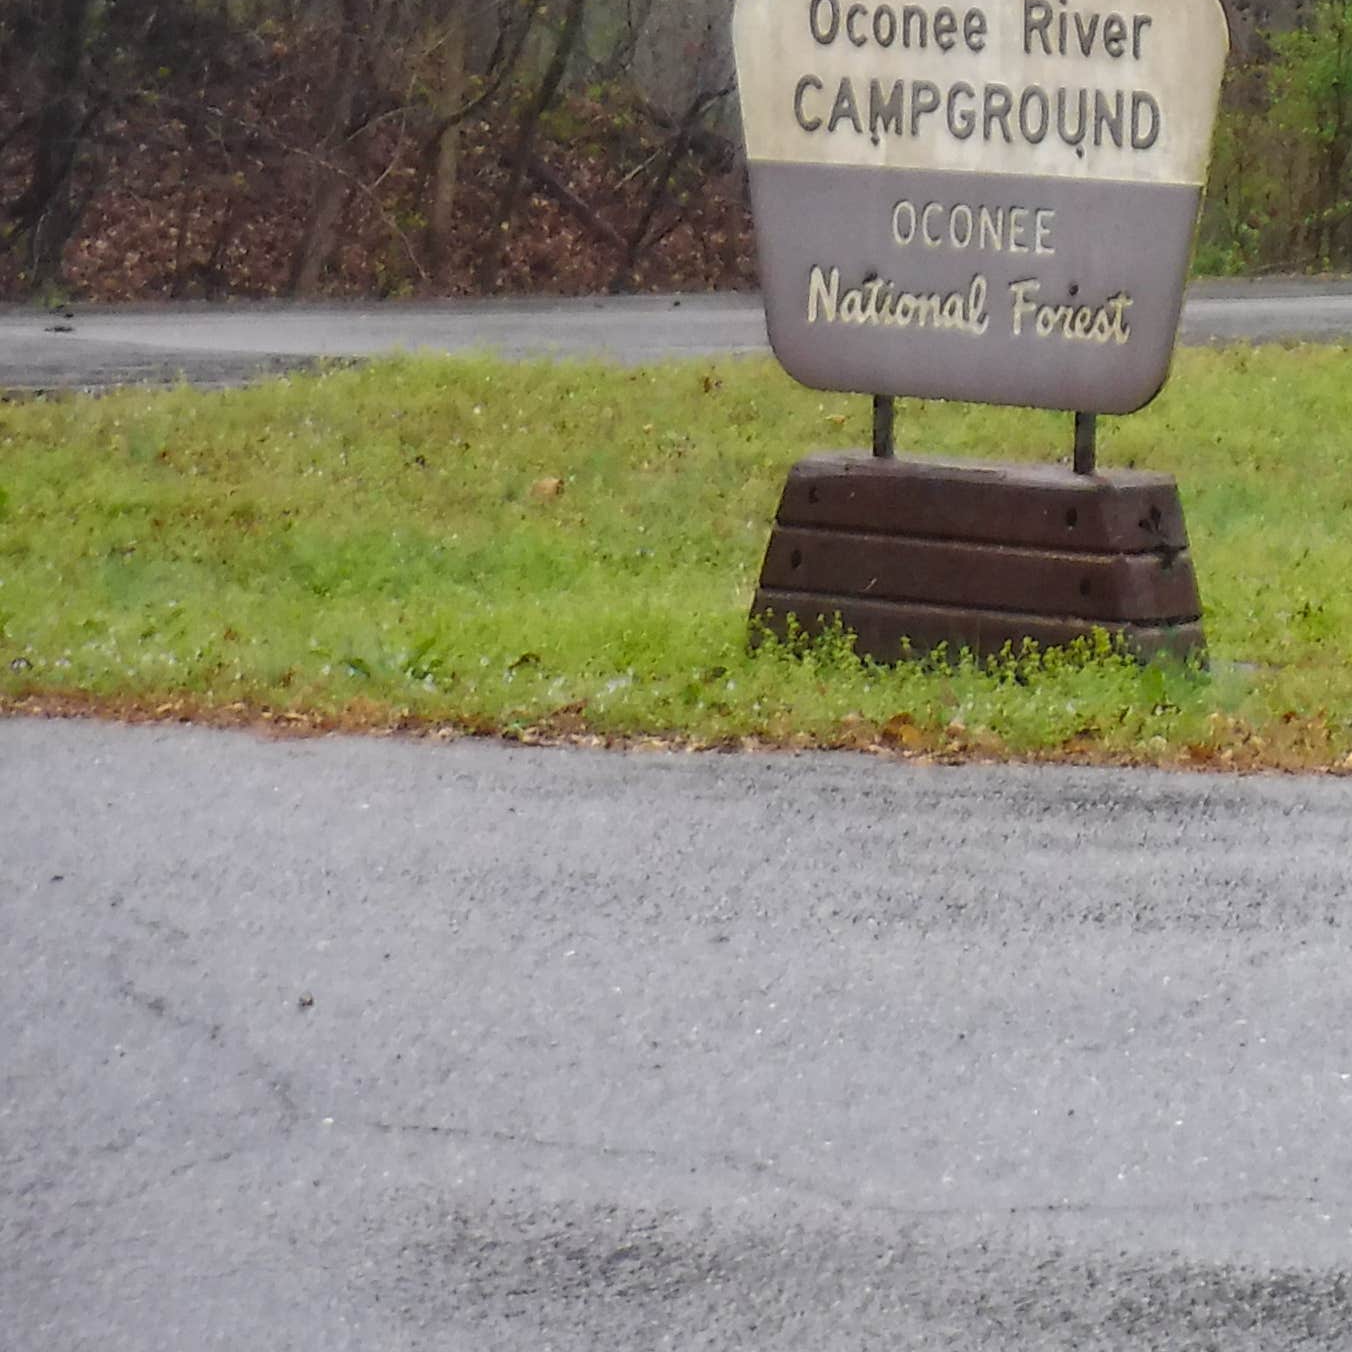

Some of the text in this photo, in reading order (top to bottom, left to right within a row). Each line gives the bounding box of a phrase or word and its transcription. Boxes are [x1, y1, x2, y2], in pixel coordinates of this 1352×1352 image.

[794, 74, 1162, 150] CAMPGROUND
[892, 199, 1056, 255] OCONEE
[807, 264, 1134, 344] National Forest
